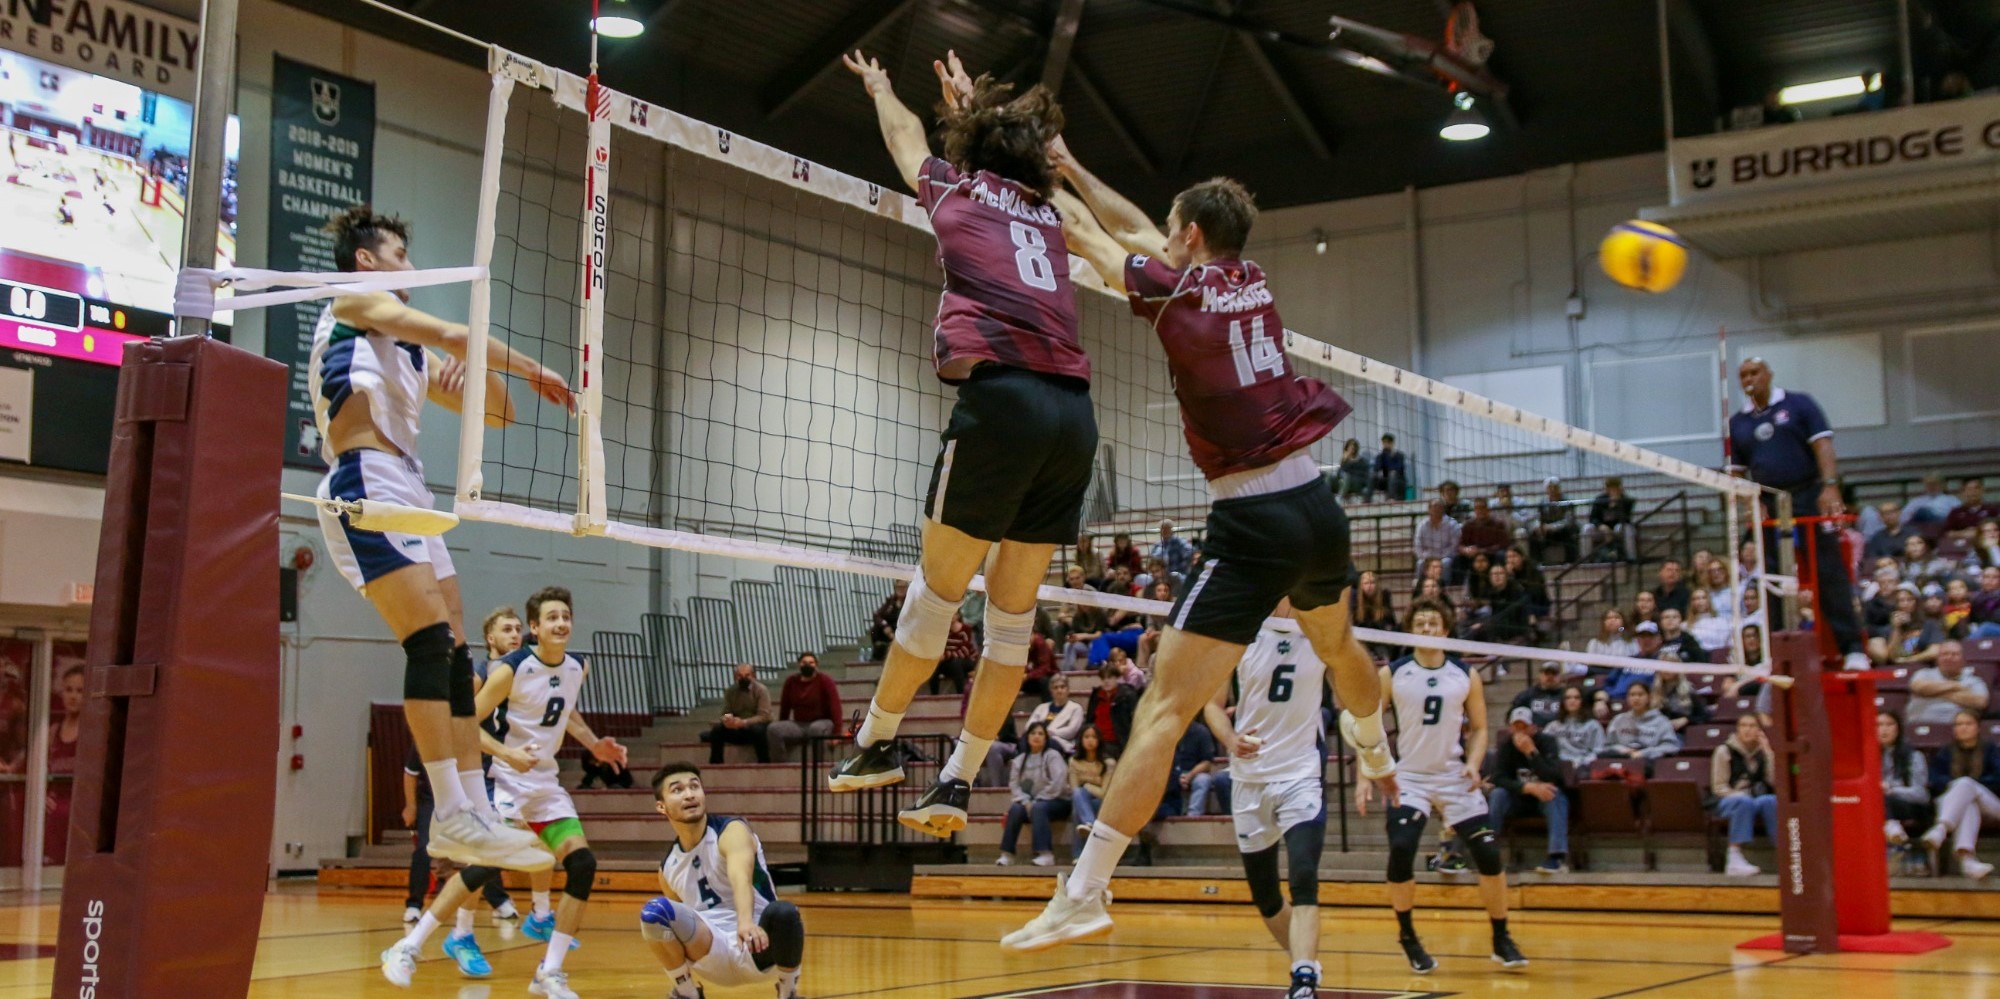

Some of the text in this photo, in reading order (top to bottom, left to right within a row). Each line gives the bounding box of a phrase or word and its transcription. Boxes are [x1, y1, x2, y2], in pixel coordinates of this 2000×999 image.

[288, 124, 360, 159] 2018-2019
[1732, 125, 1964, 183] BURRIDGE
[292, 149, 354, 181] WOMEN'S
[278, 168, 365, 207] BASKETBALL
[1010, 221, 1058, 292] 8
[1228, 314, 1285, 387] 14
[1268, 664, 1296, 703] 6
[540, 697, 565, 727] 8
[1422, 695, 1444, 725] 9
[698, 876, 722, 909] 5
[80, 900, 104, 999] sports
